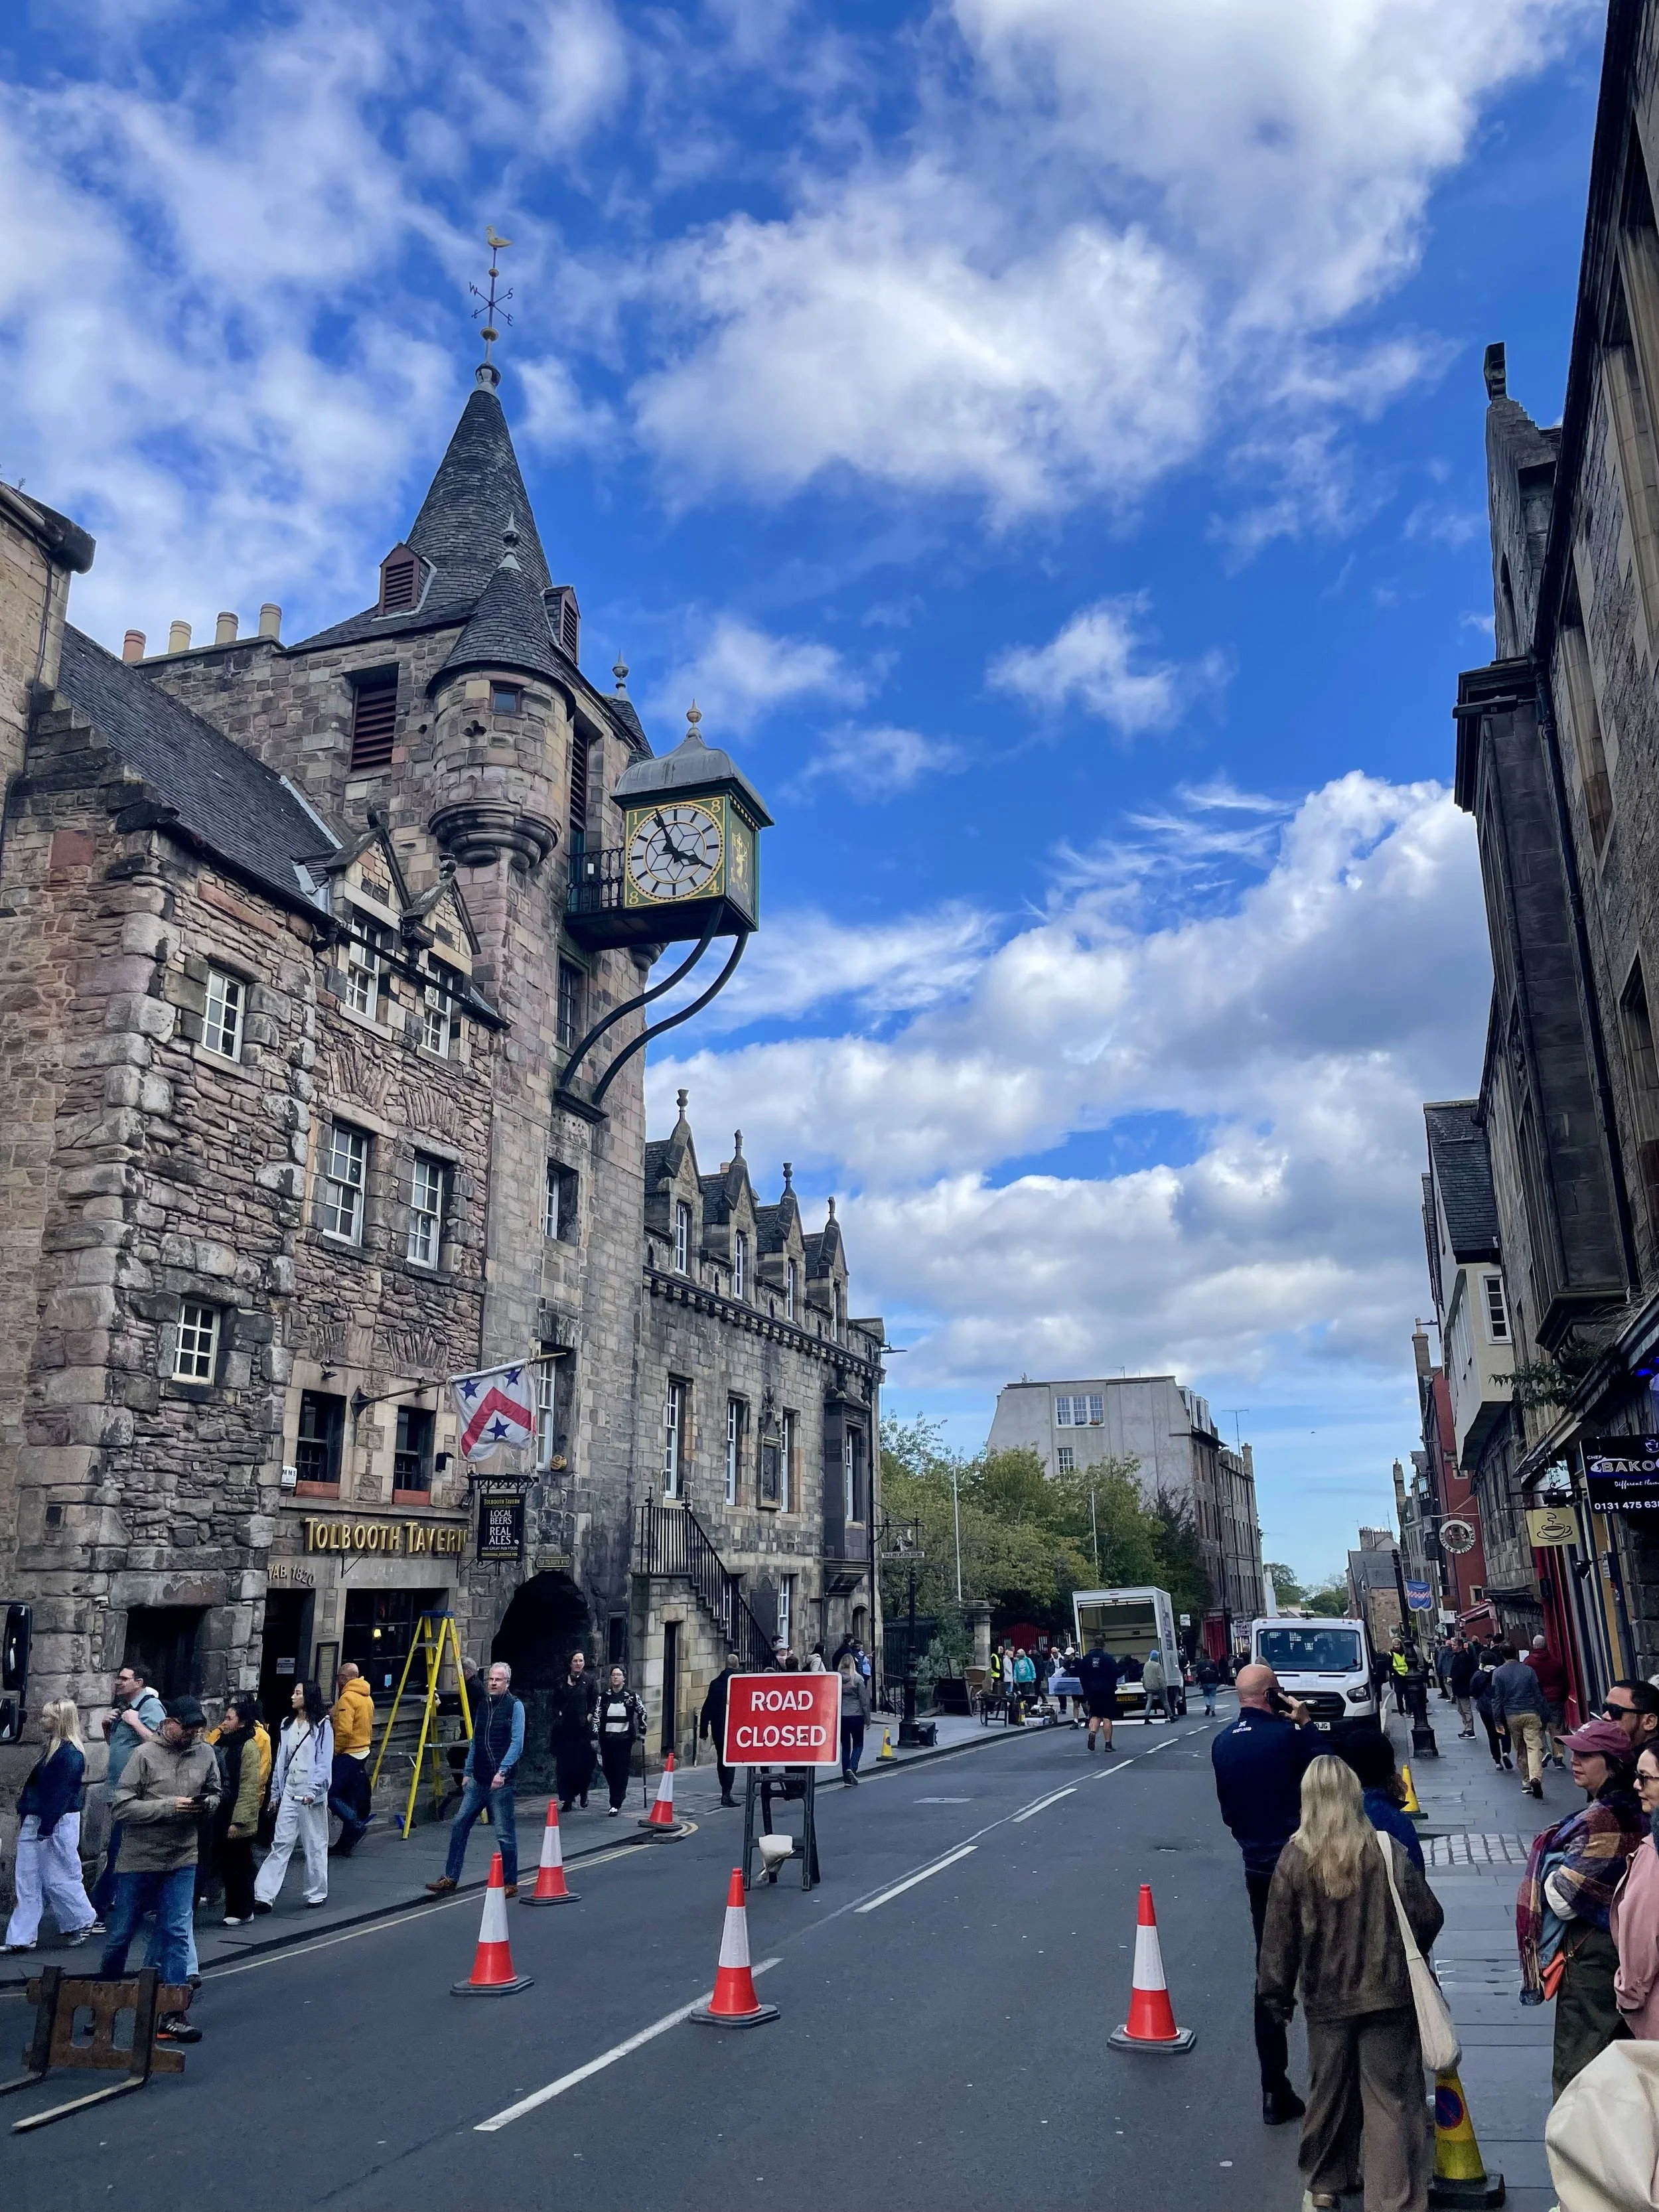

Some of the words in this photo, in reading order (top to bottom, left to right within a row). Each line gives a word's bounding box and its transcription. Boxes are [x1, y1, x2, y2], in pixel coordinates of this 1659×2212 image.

[632, 812, 638, 825] 1
[711, 800, 721, 814] 8
[628, 891, 639, 905] 8
[709, 880, 719, 894] 4
[305, 1518, 400, 1552] TOLBOOTH
[405, 1522, 468, 1553] TAVERN
[488, 1535, 511, 1545] ALES
[490, 1526, 512, 1536] REAL
[292, 1564, 315, 1586] 1820
[751, 1690, 814, 1712] ROAD
[736, 1725, 828, 1747] CLOSED
